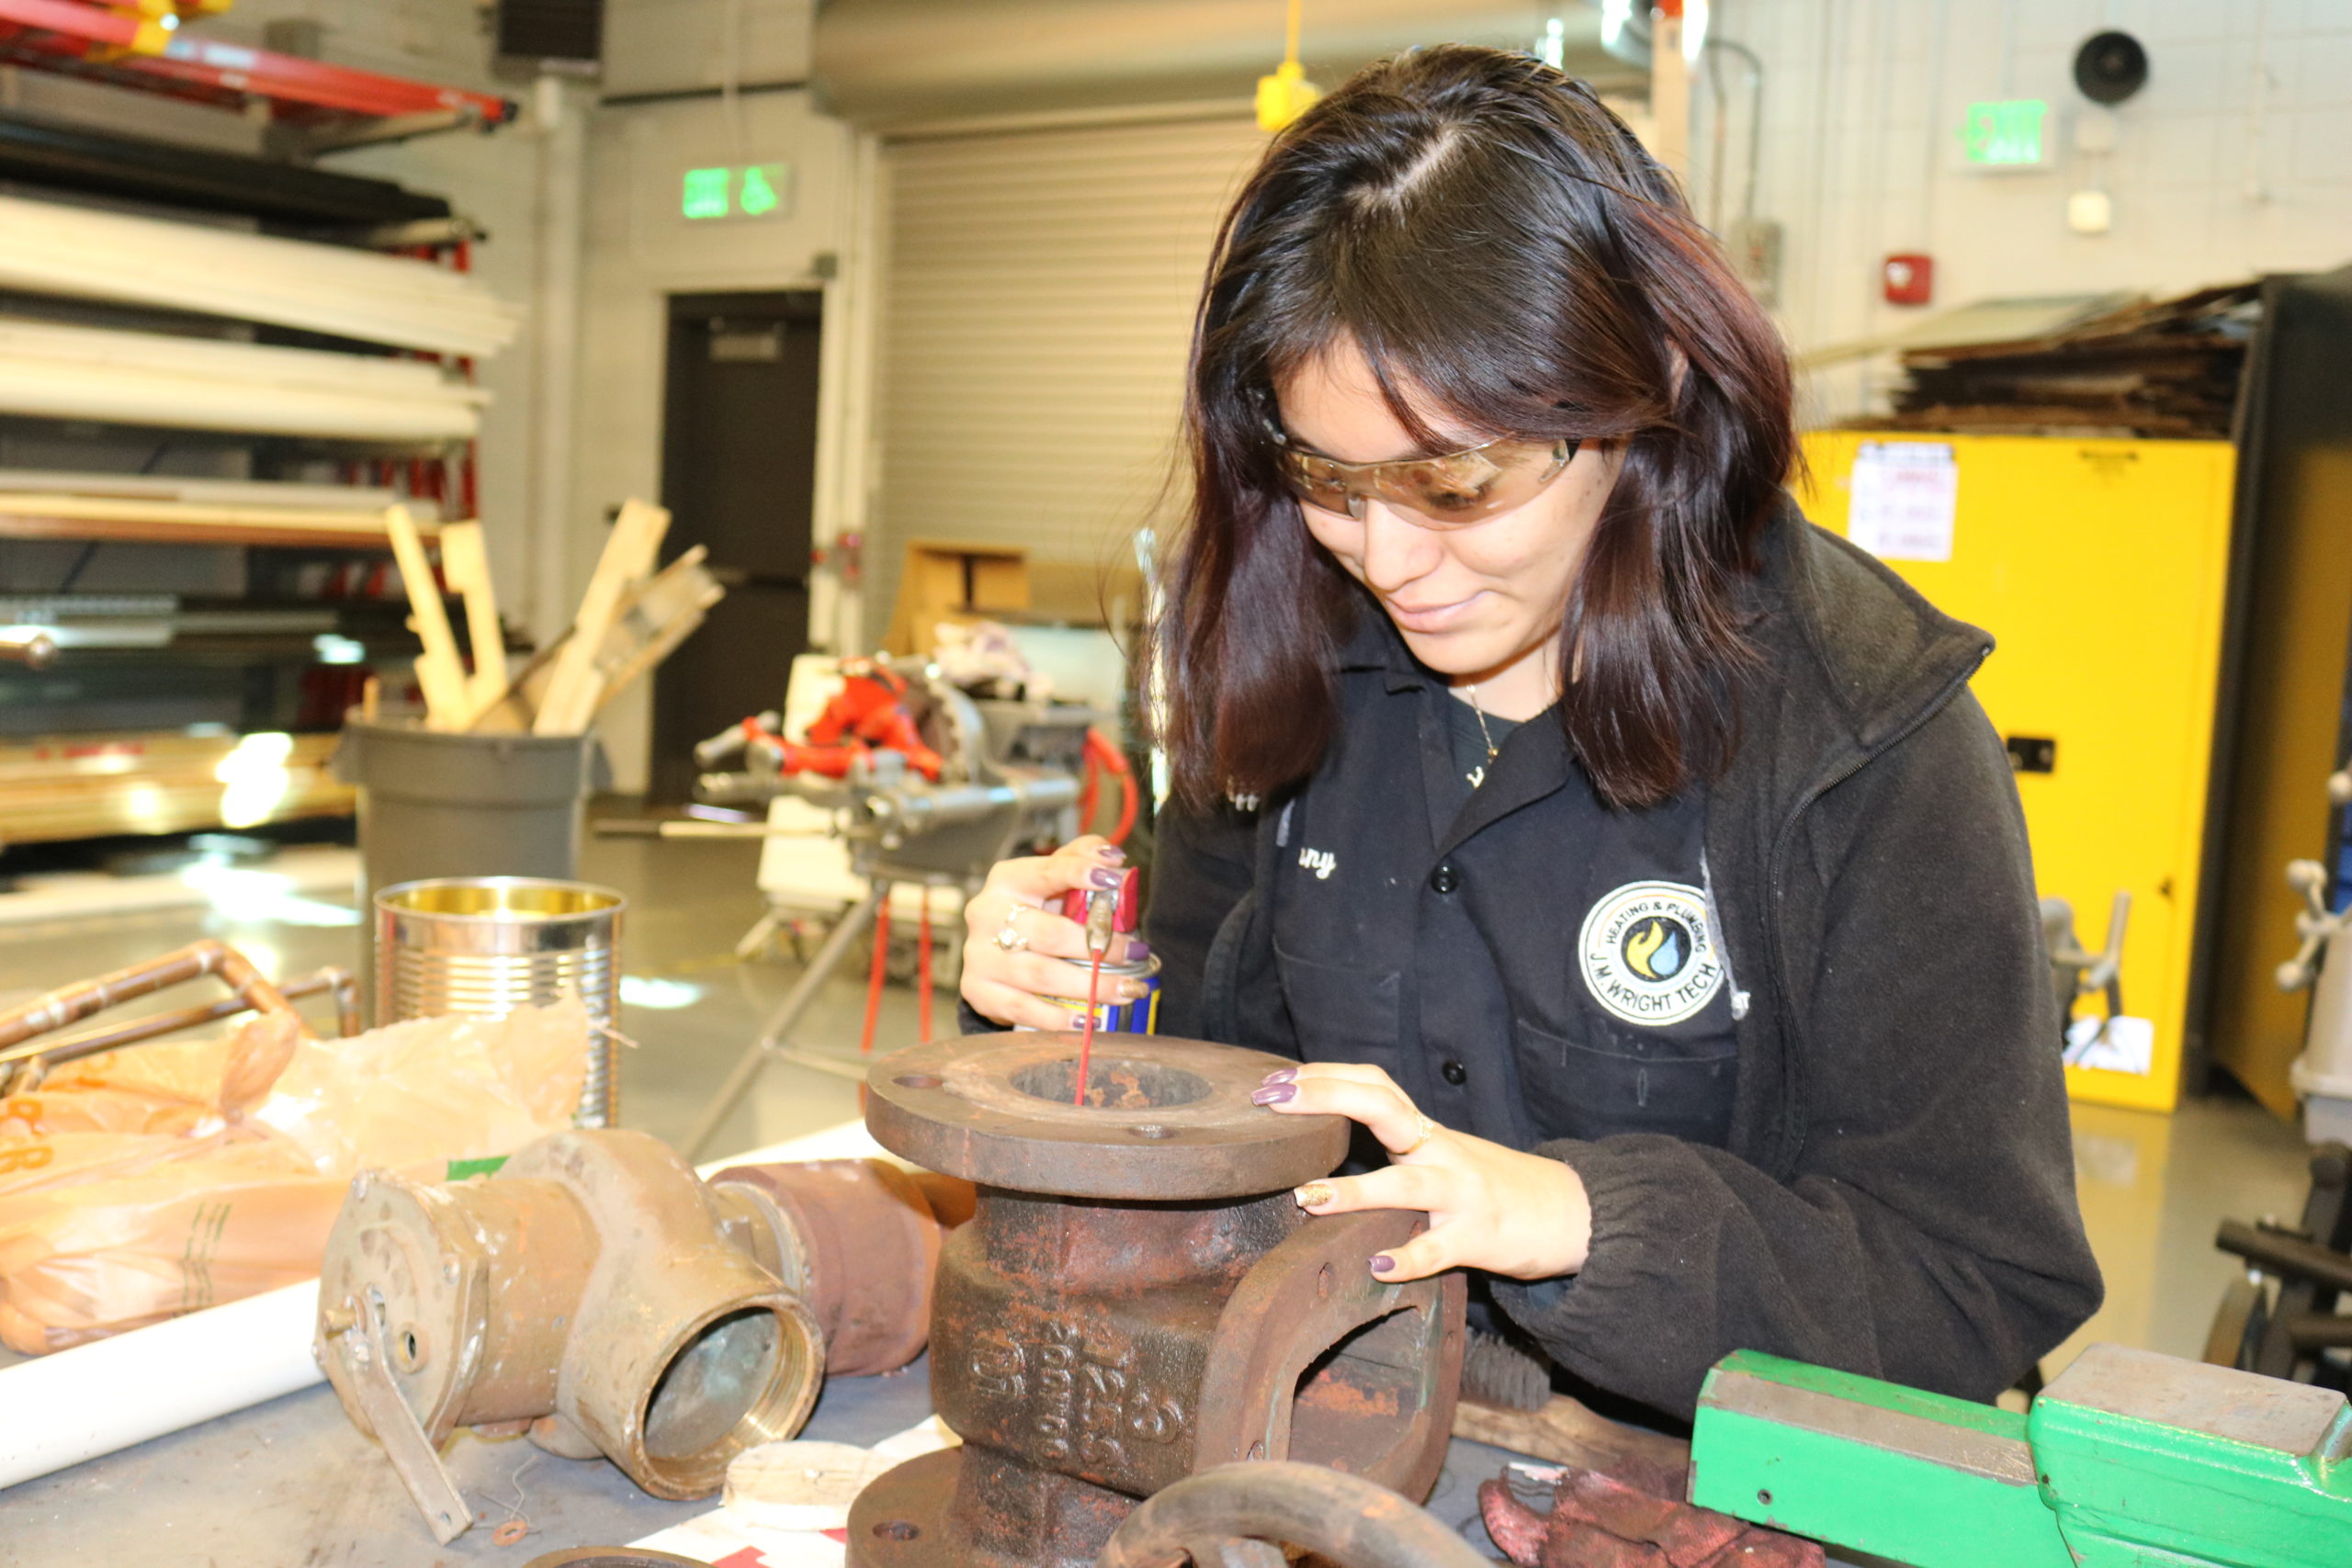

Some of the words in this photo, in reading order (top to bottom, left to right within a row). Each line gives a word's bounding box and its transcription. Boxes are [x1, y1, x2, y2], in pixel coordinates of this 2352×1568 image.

[1607, 902, 1648, 944] HEATING
[1653, 901, 1662, 909] &
[1667, 903, 1707, 953] PLUMBING
[1607, 979, 1671, 1011] WRIGHT
[1675, 963, 1716, 1003] TECH
